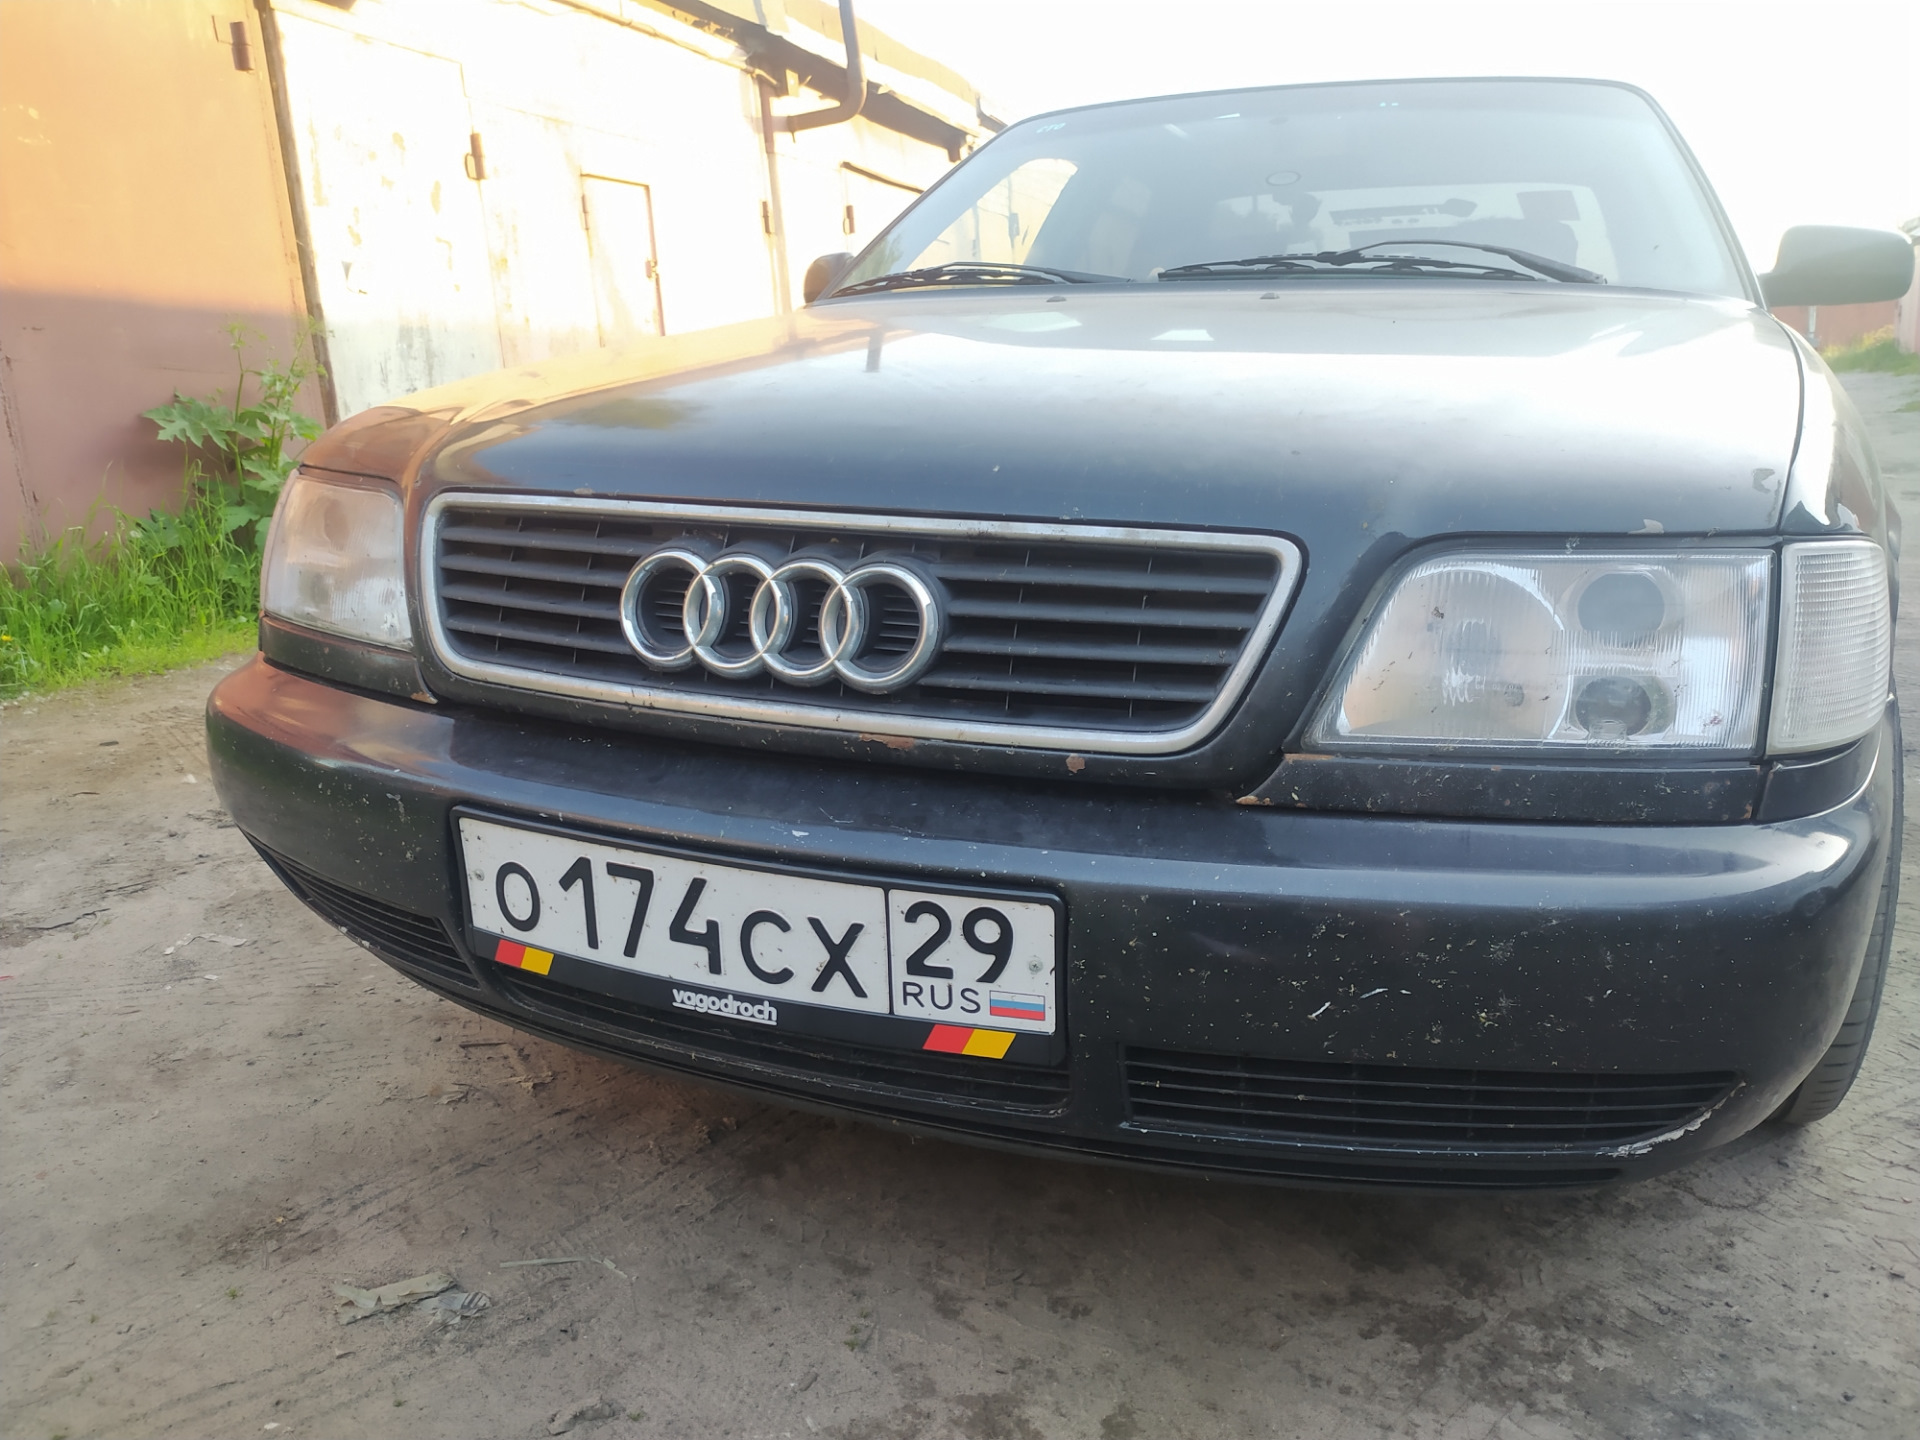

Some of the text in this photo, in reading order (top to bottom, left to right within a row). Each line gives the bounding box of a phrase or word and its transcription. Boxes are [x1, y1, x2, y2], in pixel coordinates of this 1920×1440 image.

[495, 856, 1014, 998] O174CX 29
[672, 988, 778, 1022] vagodroch
[902, 981, 982, 1014] RUS
